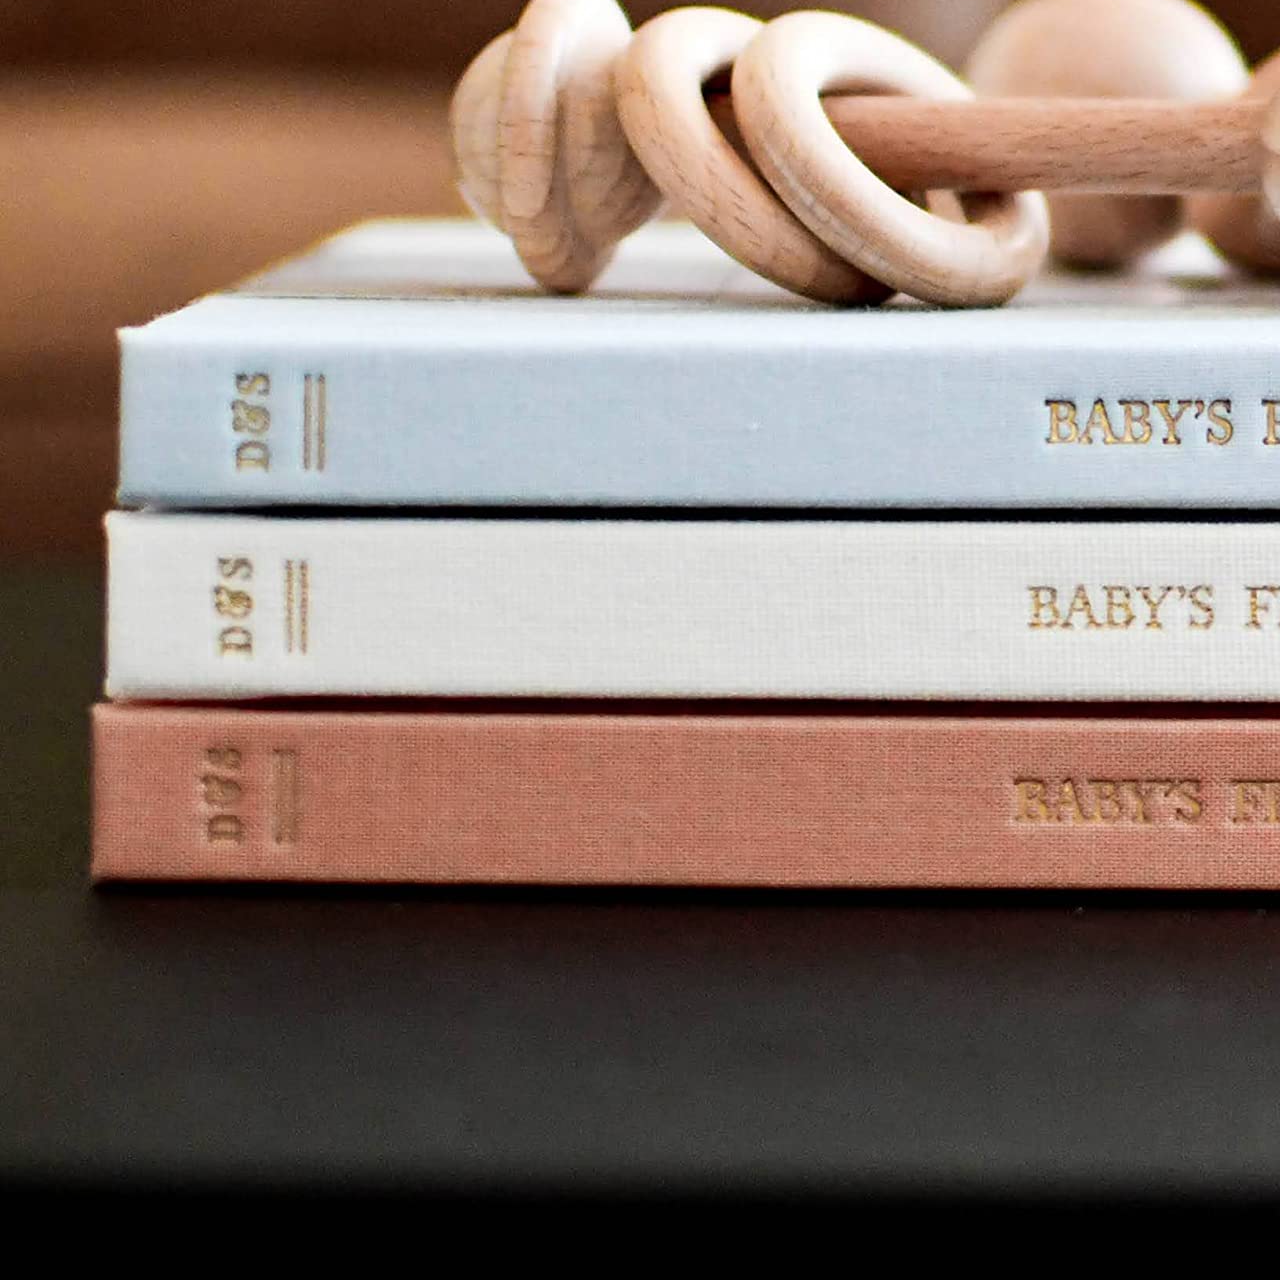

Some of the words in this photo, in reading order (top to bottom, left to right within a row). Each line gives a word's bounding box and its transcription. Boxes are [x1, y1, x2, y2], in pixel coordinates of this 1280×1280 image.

[231, 372, 272, 473] D&S
[1045, 398, 1234, 445] BABY'S
[214, 556, 254, 657] D&S
[1027, 584, 1215, 630] BABY'S
[1013, 777, 1205, 823] BABY'S
